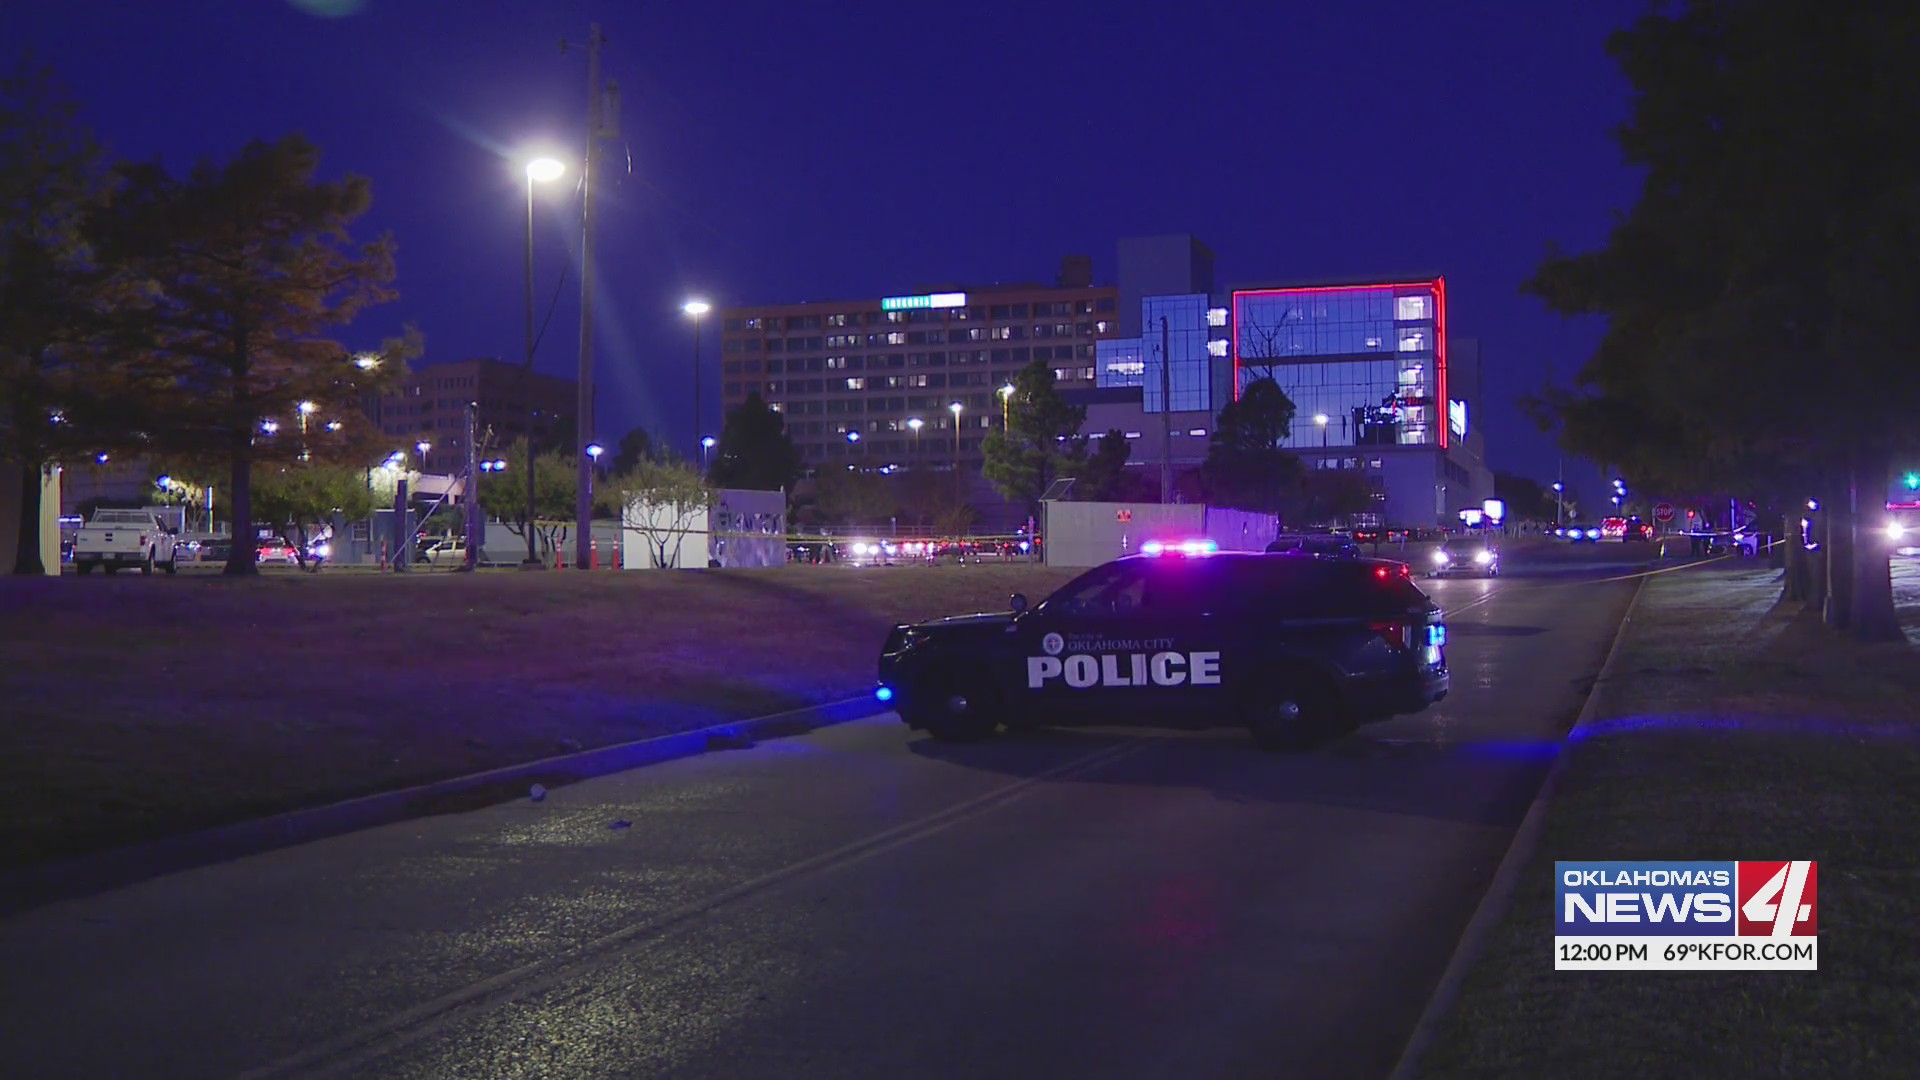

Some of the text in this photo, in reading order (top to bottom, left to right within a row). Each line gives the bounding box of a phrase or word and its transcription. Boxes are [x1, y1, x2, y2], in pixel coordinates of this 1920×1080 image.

[1656, 508, 1673, 516] STOP
[1068, 638, 1174, 651] OKLAHOMA CITY
[1027, 651, 1221, 688] POLICE
